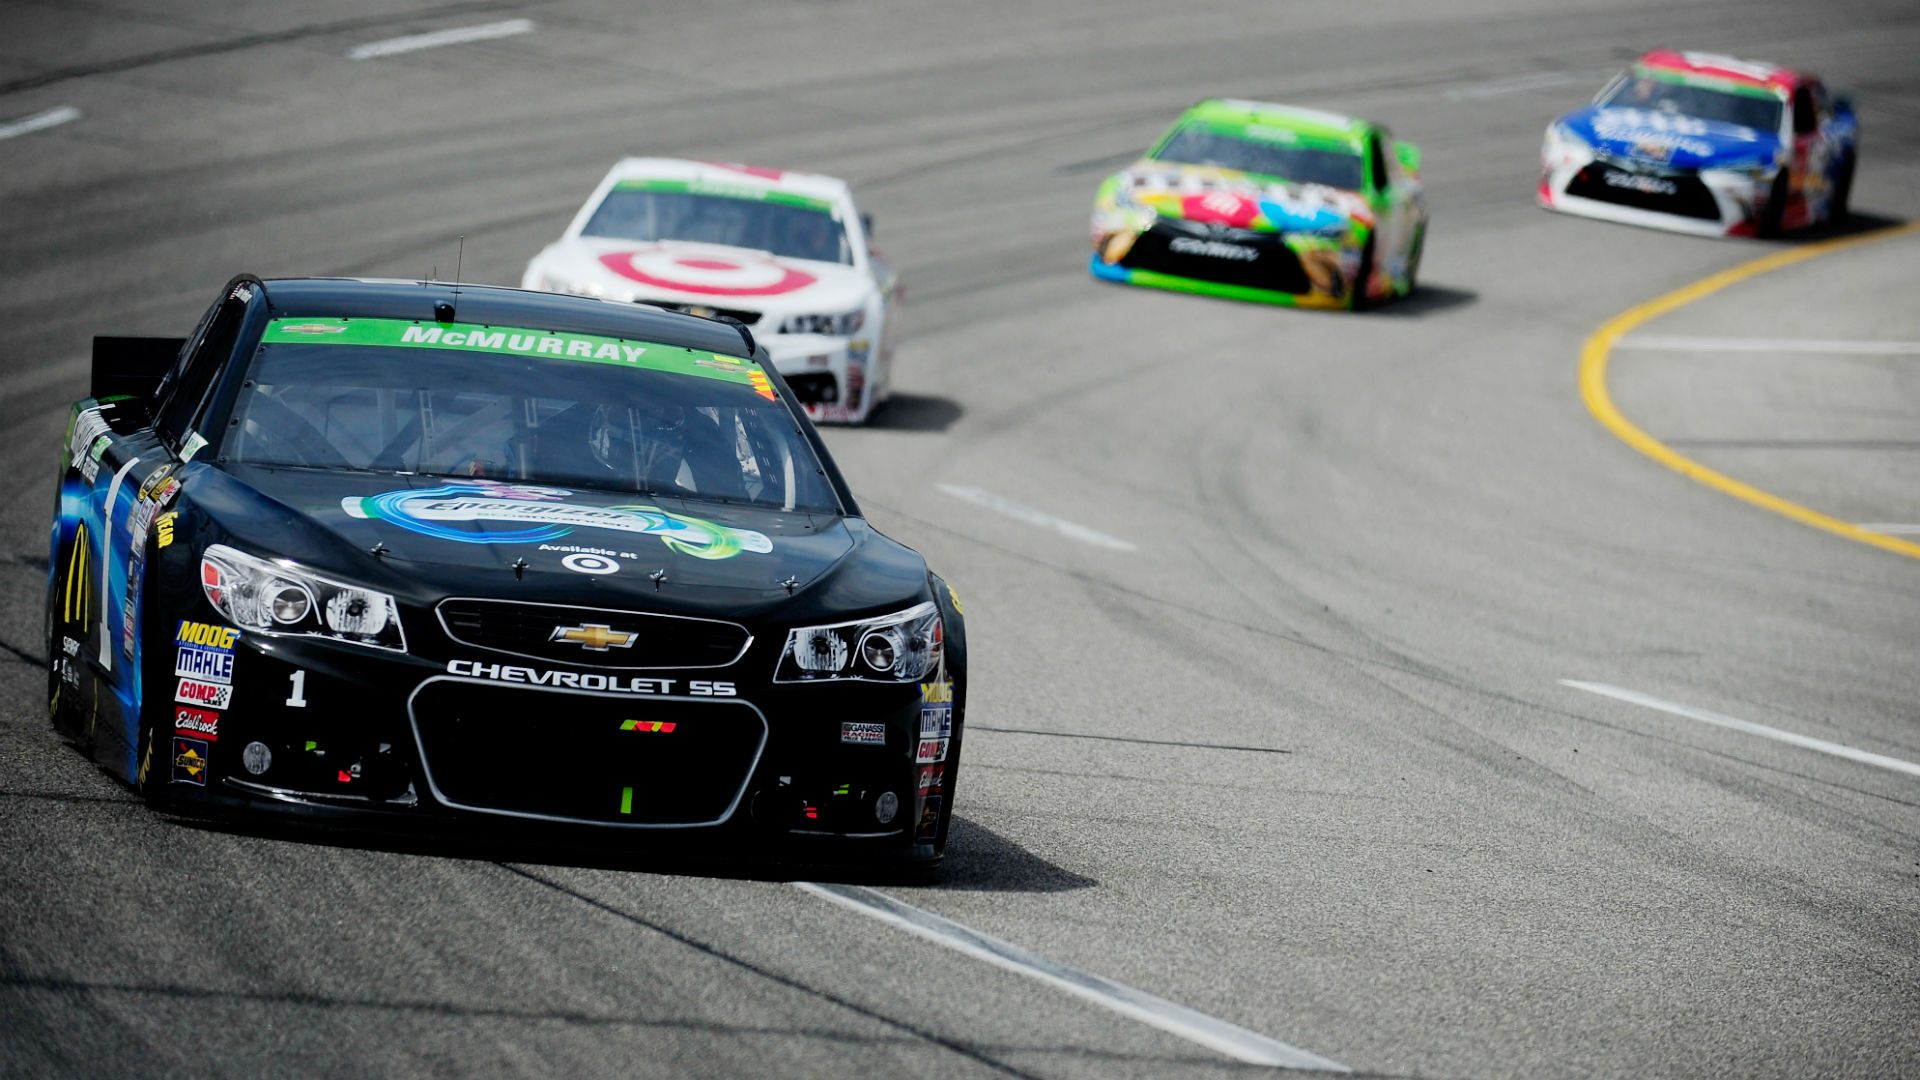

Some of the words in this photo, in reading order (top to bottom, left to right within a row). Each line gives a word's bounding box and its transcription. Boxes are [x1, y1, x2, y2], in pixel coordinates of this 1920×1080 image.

[401, 326, 647, 363] McMURRAY
[423, 500, 634, 520] Energizer
[538, 543, 617, 557] Available
[619, 552, 639, 560] at
[176, 620, 241, 649] MOOG
[178, 649, 231, 677] MAHLE
[286, 670, 306, 707] 1
[447, 659, 677, 694] CHEVROLET
[689, 680, 737, 696] SS
[180, 681, 218, 701] COMP
[175, 710, 218, 735] Edelbrock
[176, 754, 206, 771] SUNOCO
